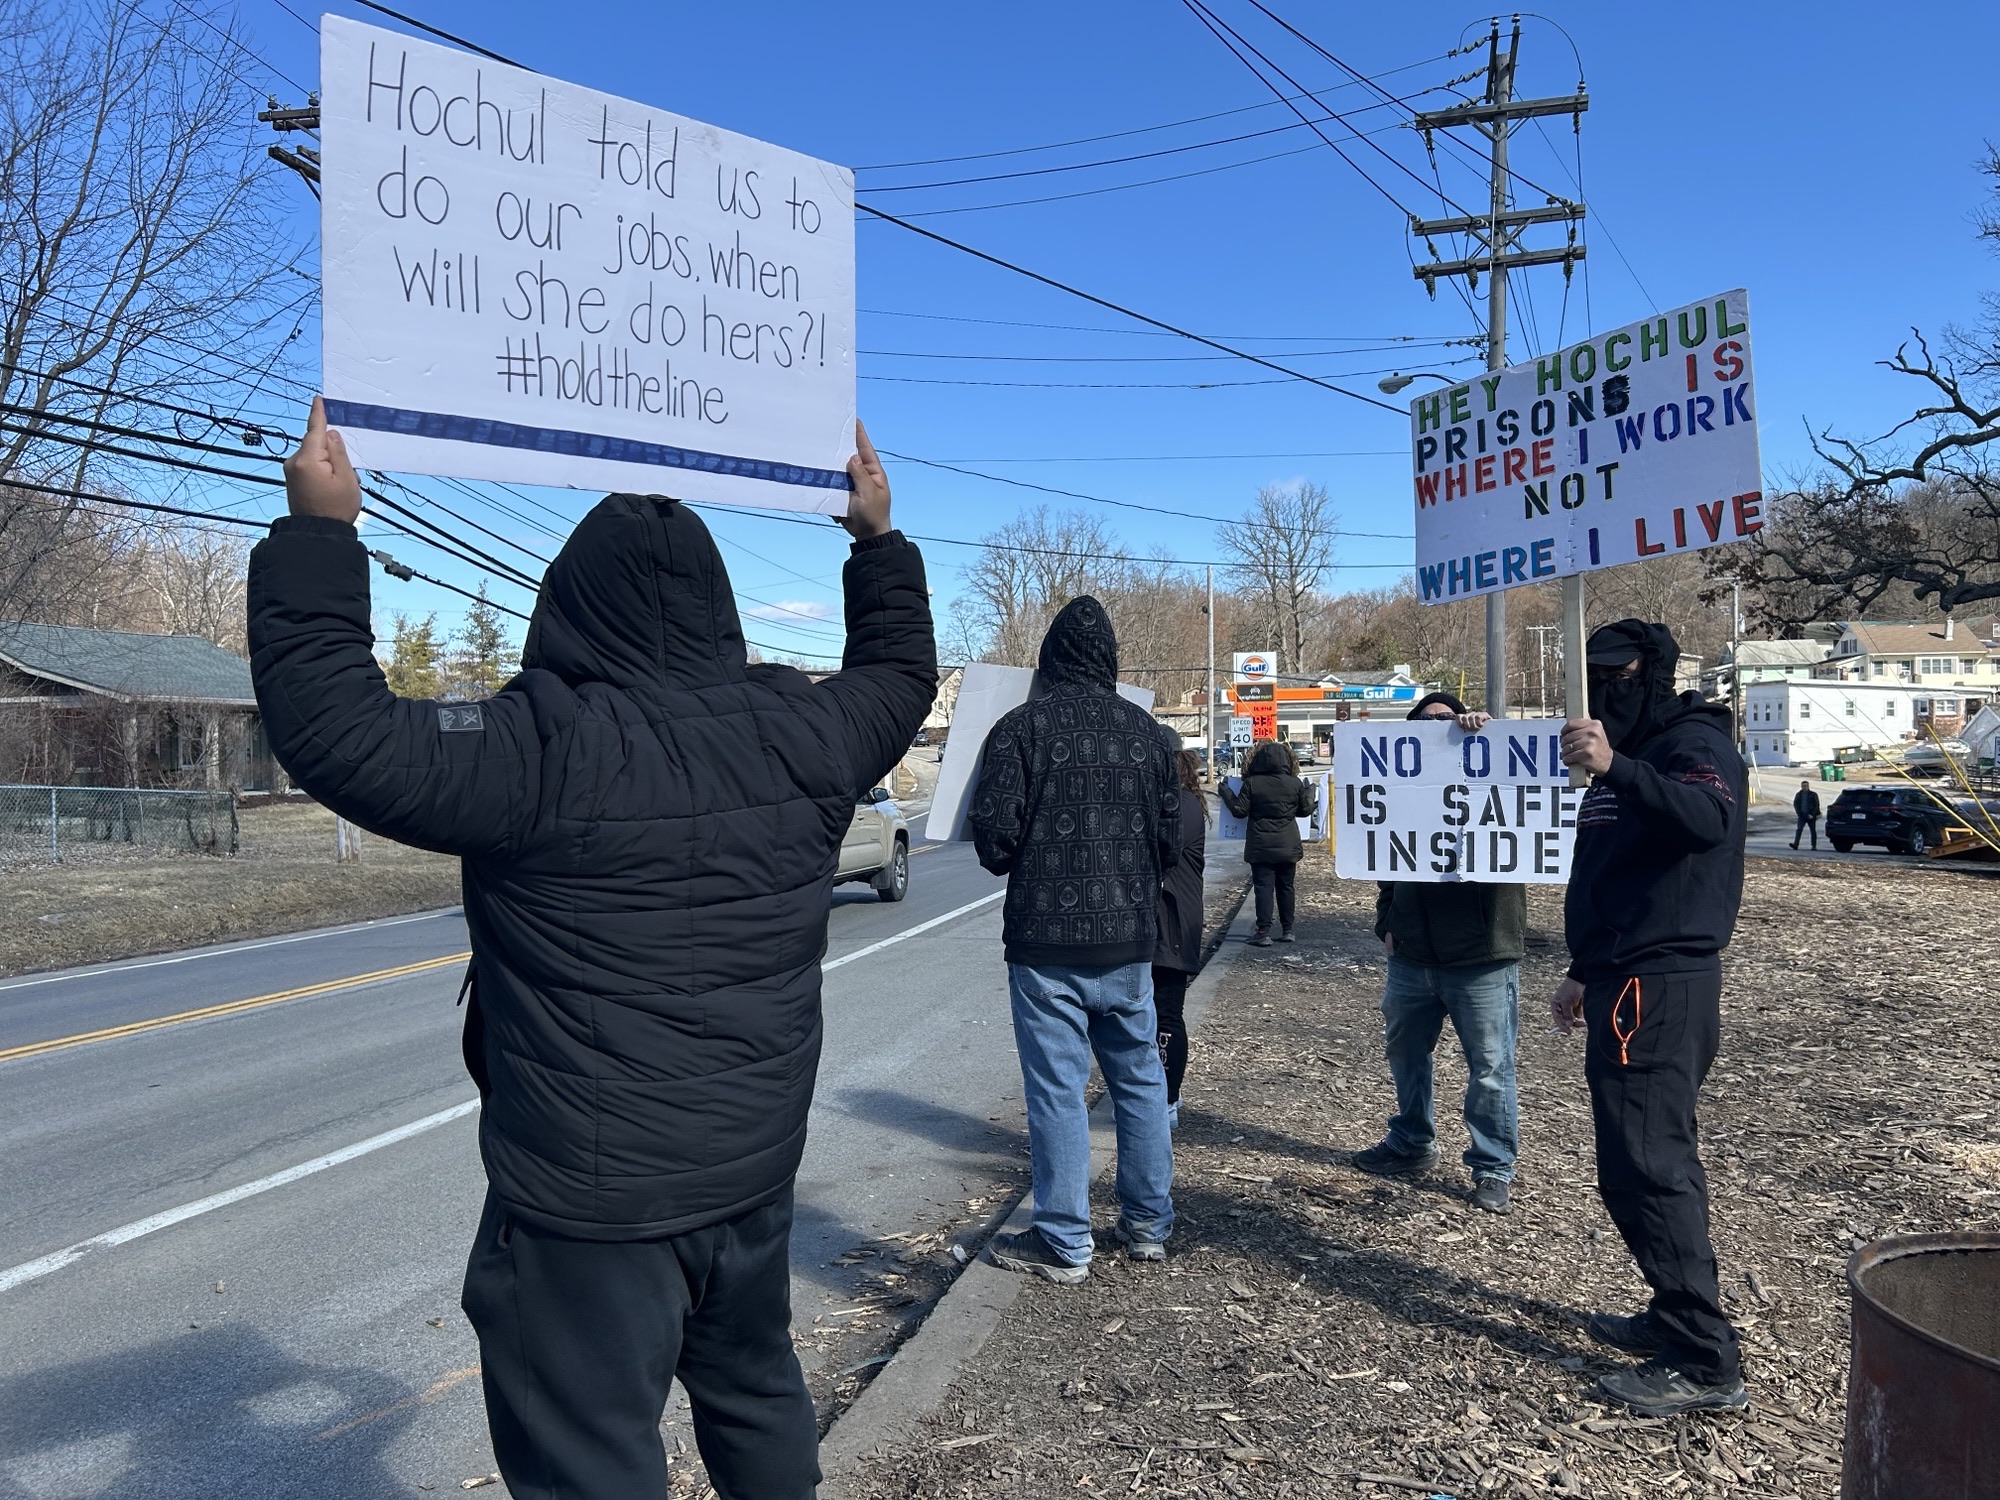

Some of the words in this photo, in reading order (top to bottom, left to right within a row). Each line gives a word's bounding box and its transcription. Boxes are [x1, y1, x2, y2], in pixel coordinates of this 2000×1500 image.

[368, 41, 545, 165] Hochul
[587, 104, 678, 199] told
[717, 163, 761, 220] us
[785, 176, 822, 234] to
[377, 145, 450, 224] do
[496, 190, 583, 251] our
[708, 230, 800, 302] when
[393, 245, 480, 313] Will
[503, 259, 610, 335] she
[629, 281, 686, 347] do
[703, 294, 825, 368] hers?!
[496, 333, 729, 425] #holdtheline
[1418, 375, 1502, 434] HEY
[1536, 299, 1747, 396] HOCHUL
[1685, 341, 1744, 392] IS
[1415, 438, 1555, 510] WHERE
[1578, 428, 1589, 465] I
[1615, 382, 1753, 454] WORK
[1524, 462, 1619, 520] NOT
[1419, 537, 1555, 601] WHERE
[1588, 528, 1600, 566] I
[1635, 491, 1765, 557] LIVE
[1244, 664, 1267, 672] Gulf
[1363, 687, 1396, 699] Gulf
[1233, 734, 1251, 743] 40
[1361, 736, 1422, 778] NO
[1346, 784, 1387, 825] IS
[1442, 784, 1576, 828] SAFE
[1367, 830, 1560, 875] INSIDE
